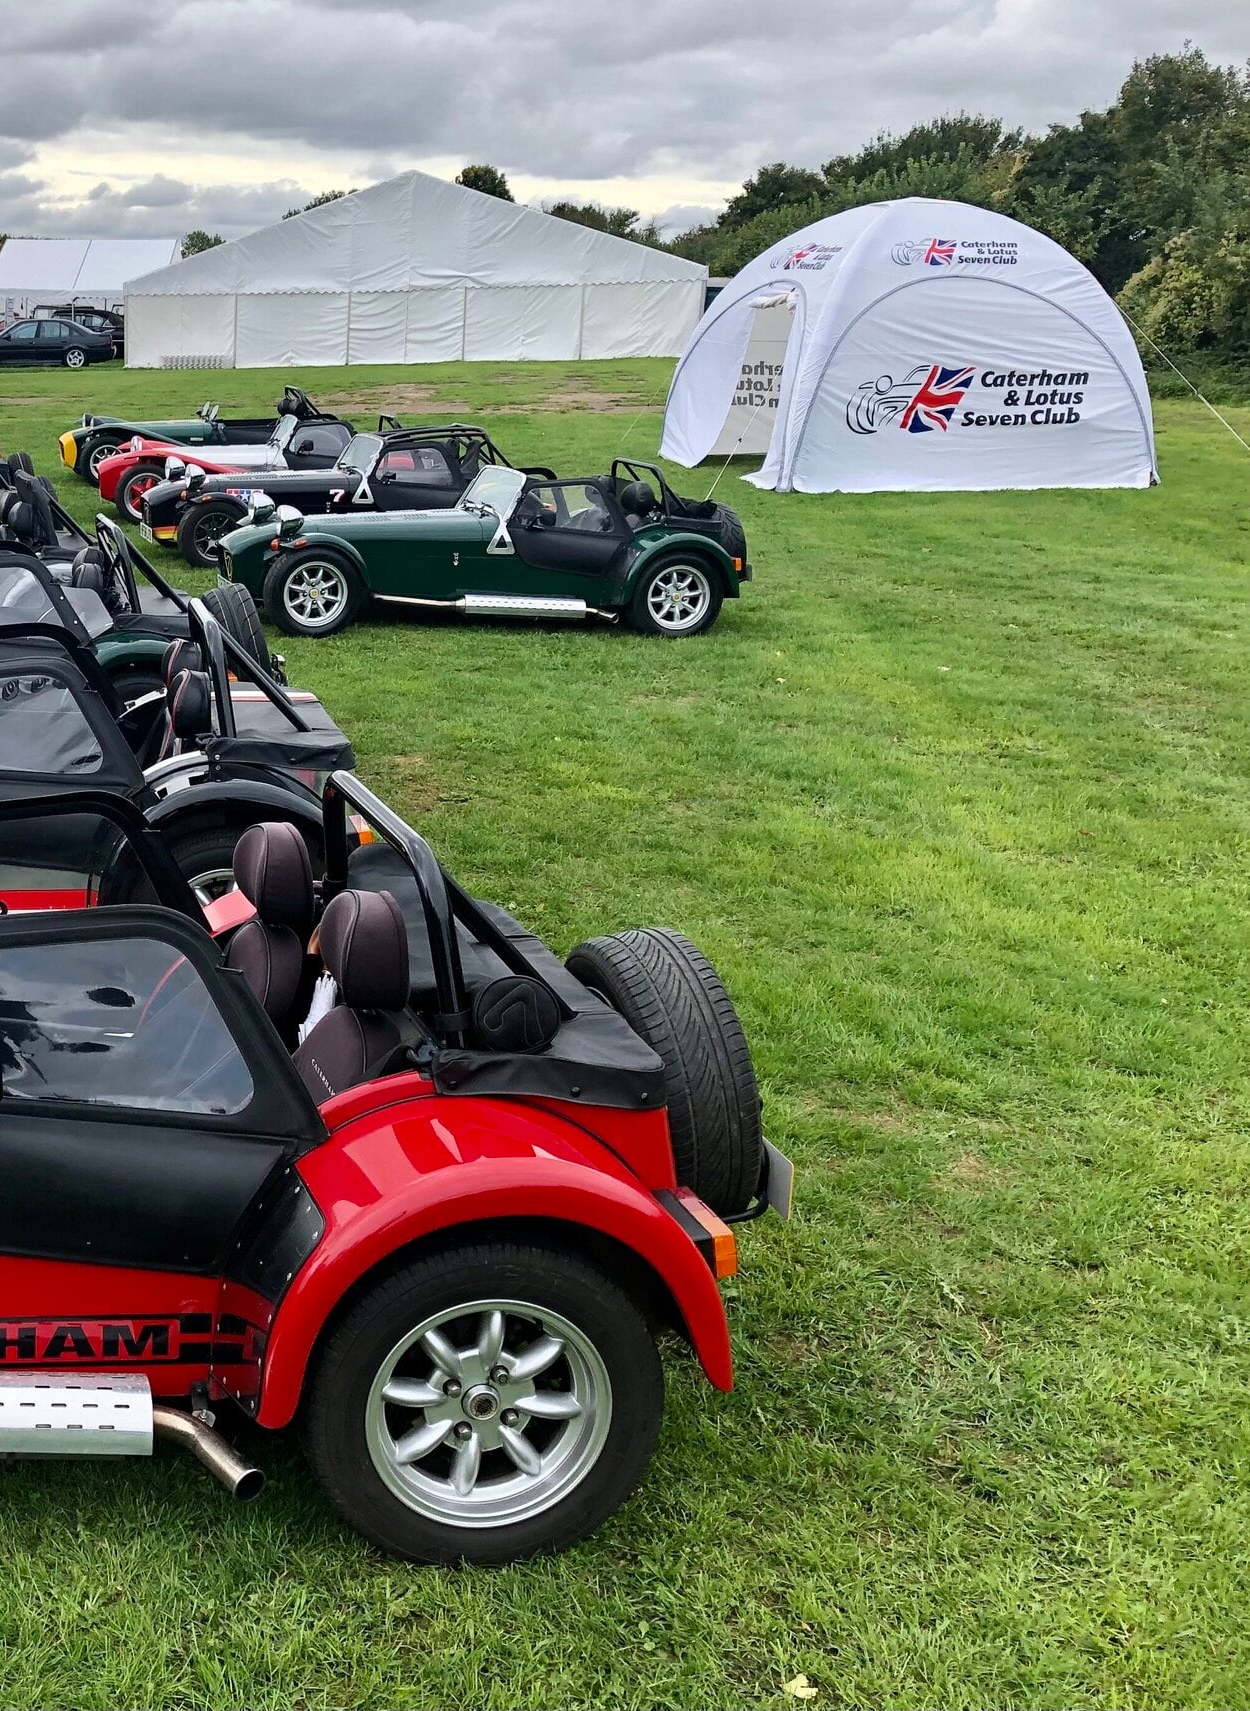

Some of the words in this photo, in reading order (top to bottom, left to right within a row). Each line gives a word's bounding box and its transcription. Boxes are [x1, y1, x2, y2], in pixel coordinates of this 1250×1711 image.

[958, 255, 990, 264] Seven
[991, 256, 1018, 265] Club
[981, 369, 1090, 388] Caterham
[1003, 389, 1020, 406] &
[1024, 389, 1084, 406] Lotus
[961, 411, 1027, 427] Seven
[1030, 407, 1081, 425] Club
[329, 488, 345, 502] 7
